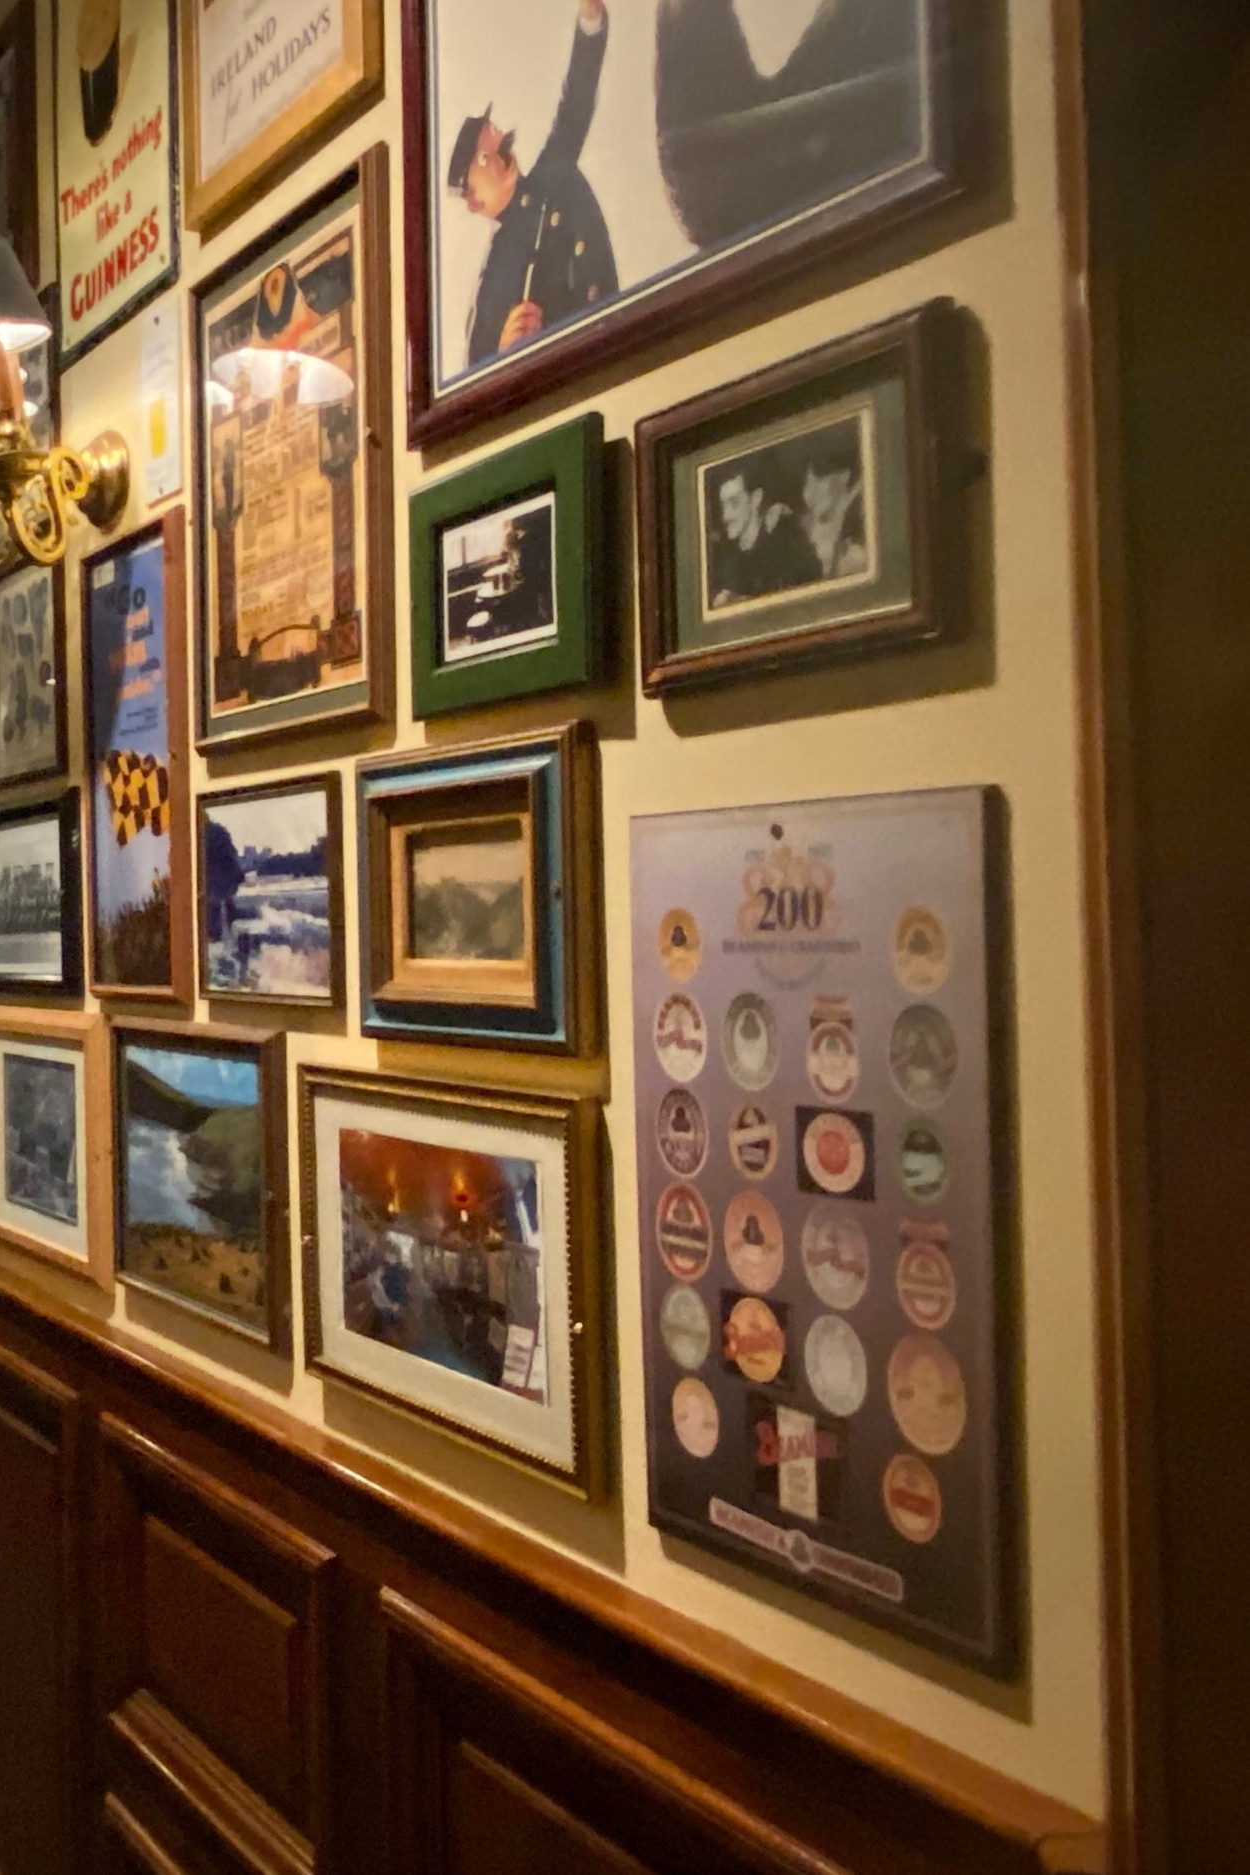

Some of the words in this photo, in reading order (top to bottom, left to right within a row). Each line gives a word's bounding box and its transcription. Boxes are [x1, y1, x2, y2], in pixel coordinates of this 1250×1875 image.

[211, 16, 277, 100] IRELAND
[252, 6, 331, 103] HOLIDAYS
[112, 105, 162, 181] nothing
[97, 199, 120, 241] like
[124, 189, 133, 215] a
[70, 206, 160, 321] GUINNESS
[757, 886, 824, 931] 200
